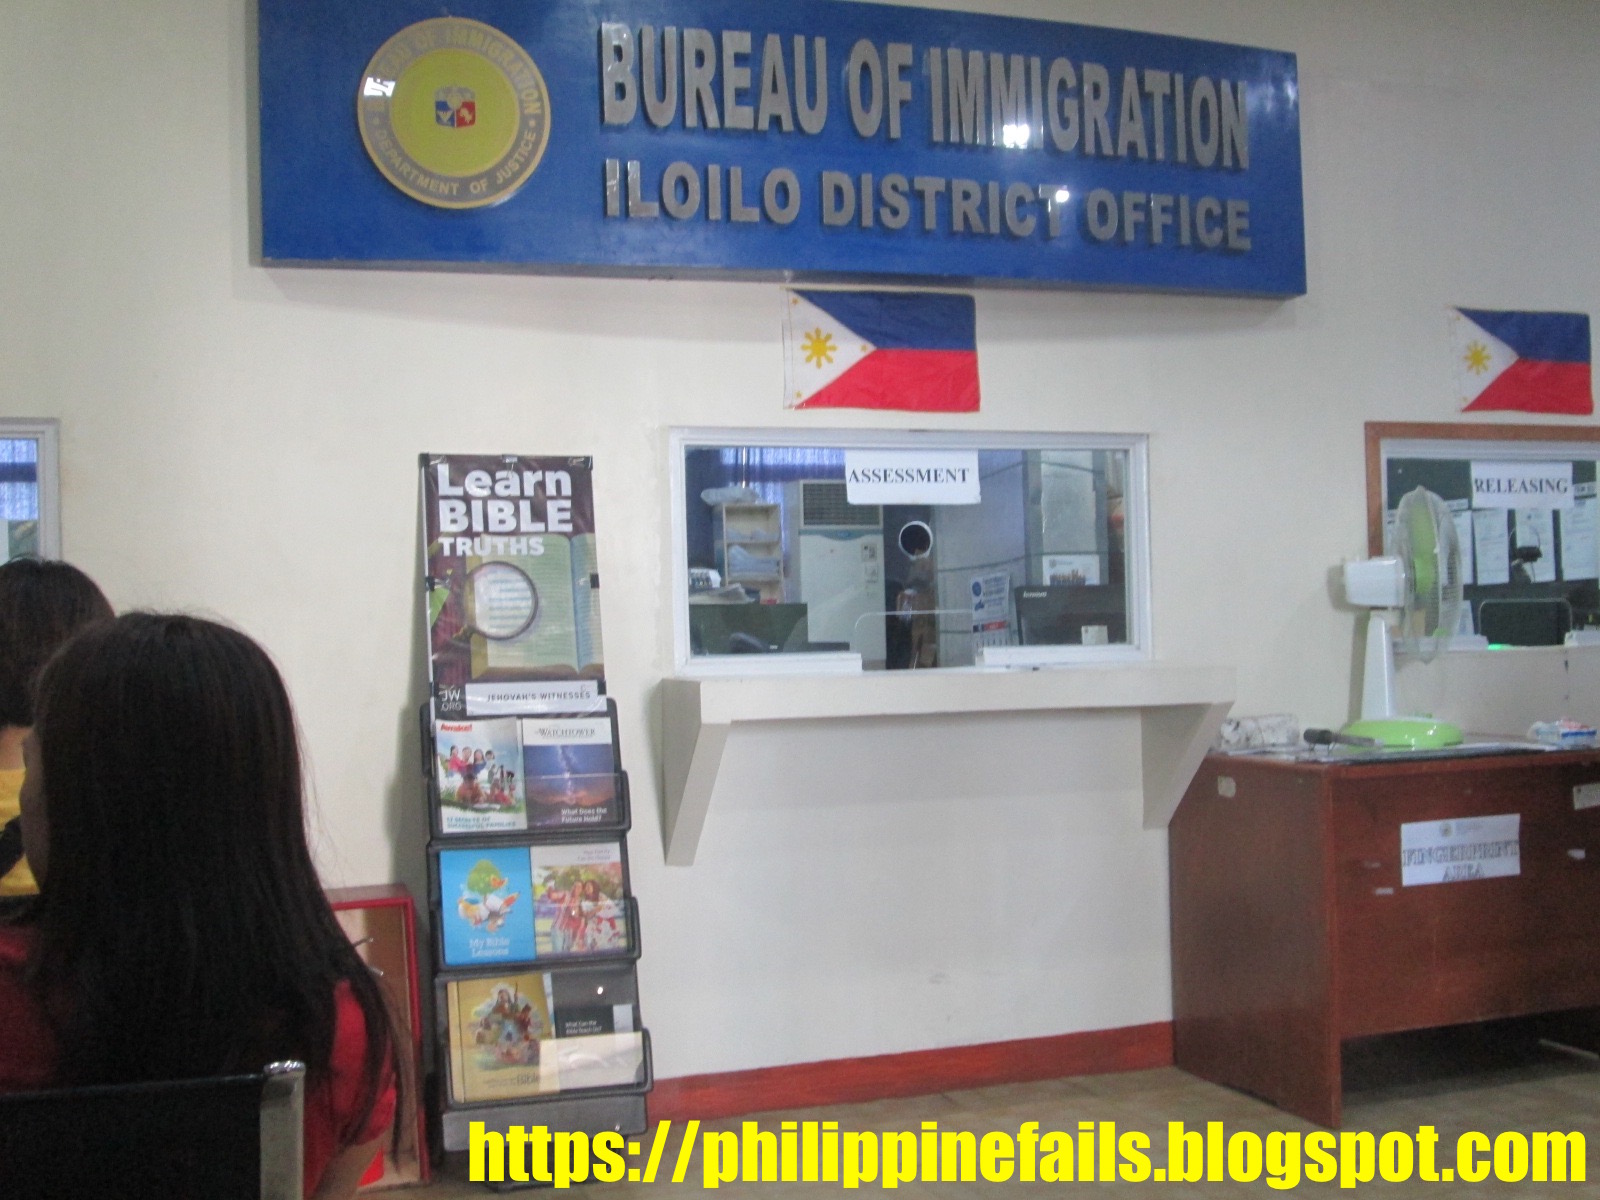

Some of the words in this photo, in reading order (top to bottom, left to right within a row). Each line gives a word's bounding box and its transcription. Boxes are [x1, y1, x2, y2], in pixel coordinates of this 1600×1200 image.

[600, 21, 828, 136] BUREAU
[847, 38, 913, 140] OF
[928, 45, 1250, 171] IMMIGRATION
[375, 130, 460, 196] DEPARTMENT
[469, 178, 489, 195] OF
[495, 131, 537, 185] JUSTICE
[605, 157, 801, 226] ILOILO
[821, 170, 1070, 238] DISTRICT
[1086, 188, 1252, 252] OFFICE
[437, 463, 573, 498] Learn
[848, 467, 970, 484] ASSESSMENT
[1473, 477, 1569, 495] RELEASING
[438, 499, 573, 533] BIBLE
[438, 537, 545, 557] TRUTHS
[487, 692, 537, 702] JEHOVAH'S
[540, 690, 591, 700] WITNESSES
[1401, 839, 1521, 868] FINGERPRINT
